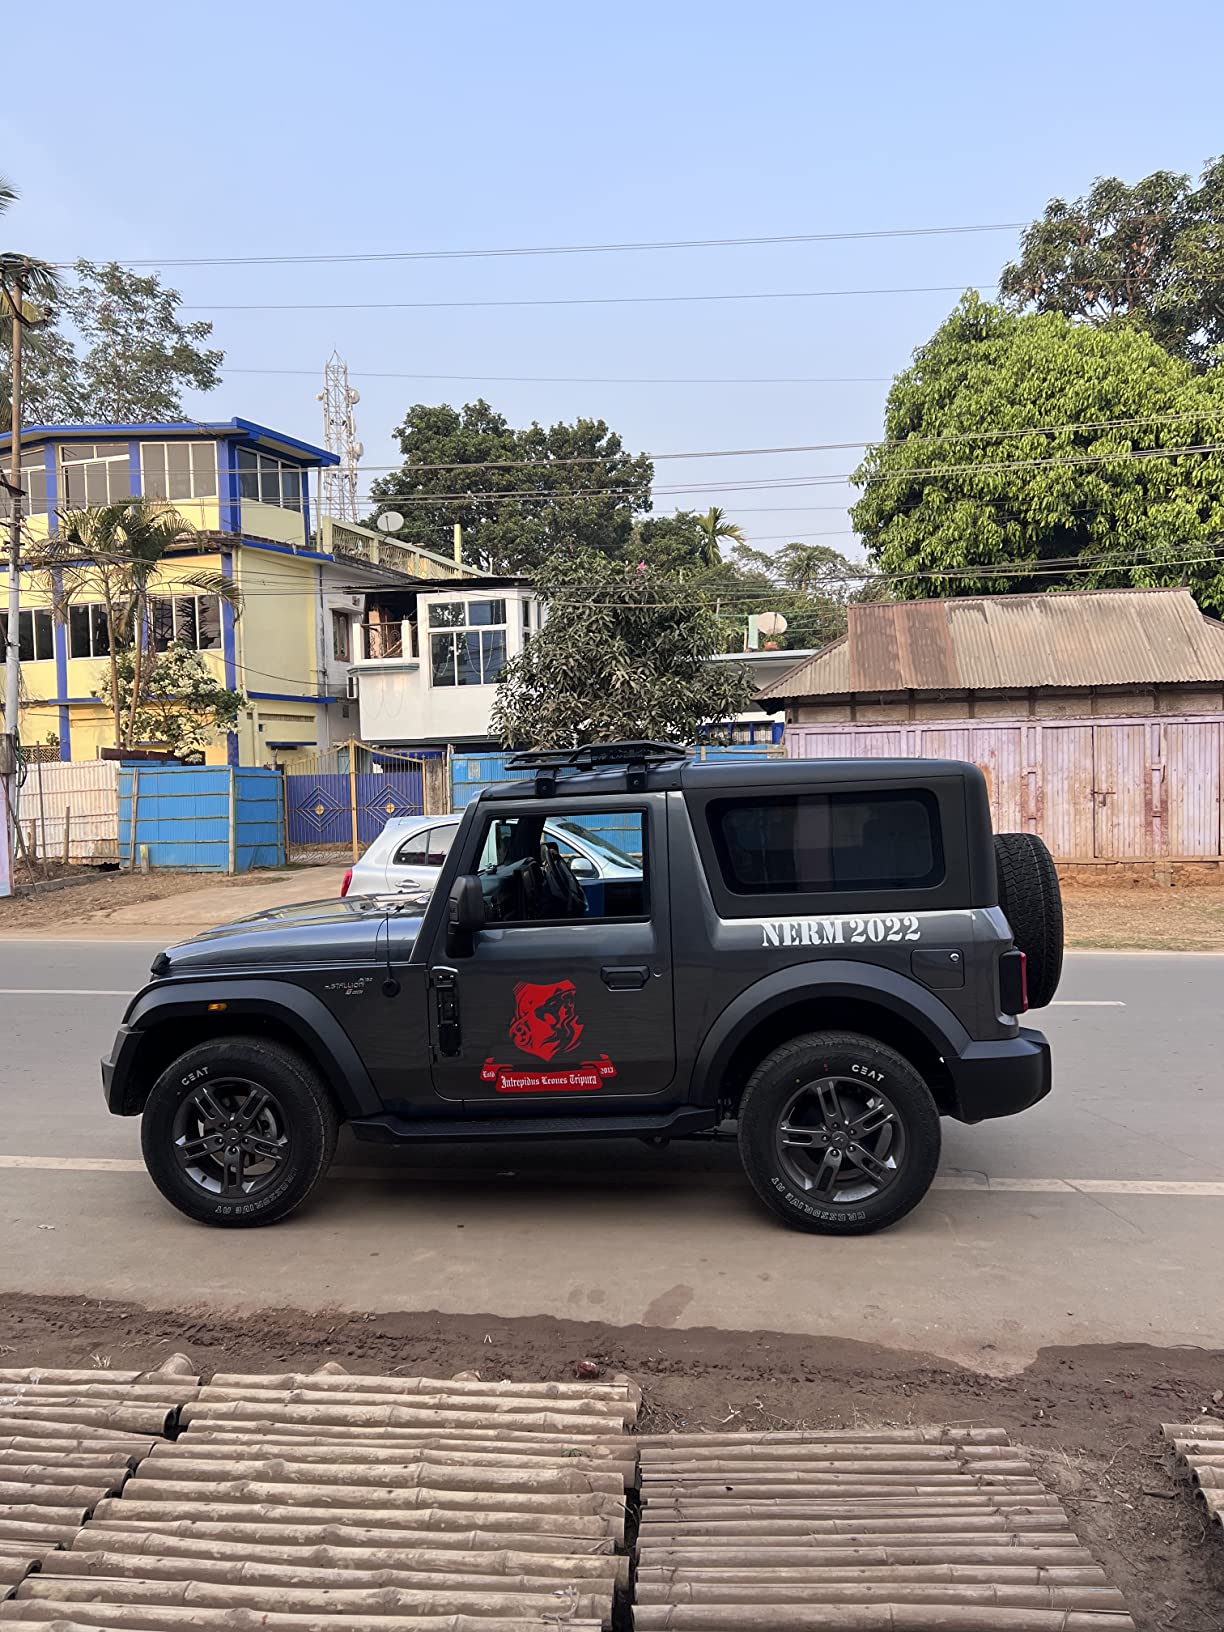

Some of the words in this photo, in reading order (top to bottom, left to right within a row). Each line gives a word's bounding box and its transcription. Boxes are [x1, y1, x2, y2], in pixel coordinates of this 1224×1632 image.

[761, 919, 845, 946] NERM
[850, 916, 921, 943] 2022
[181, 1066, 209, 1086] CEAT
[501, 1075, 540, 1089] Intrepidus
[541, 1075, 568, 1085] Leones
[569, 1073, 597, 1086] Tripura
[851, 1064, 885, 1082] CEAT
